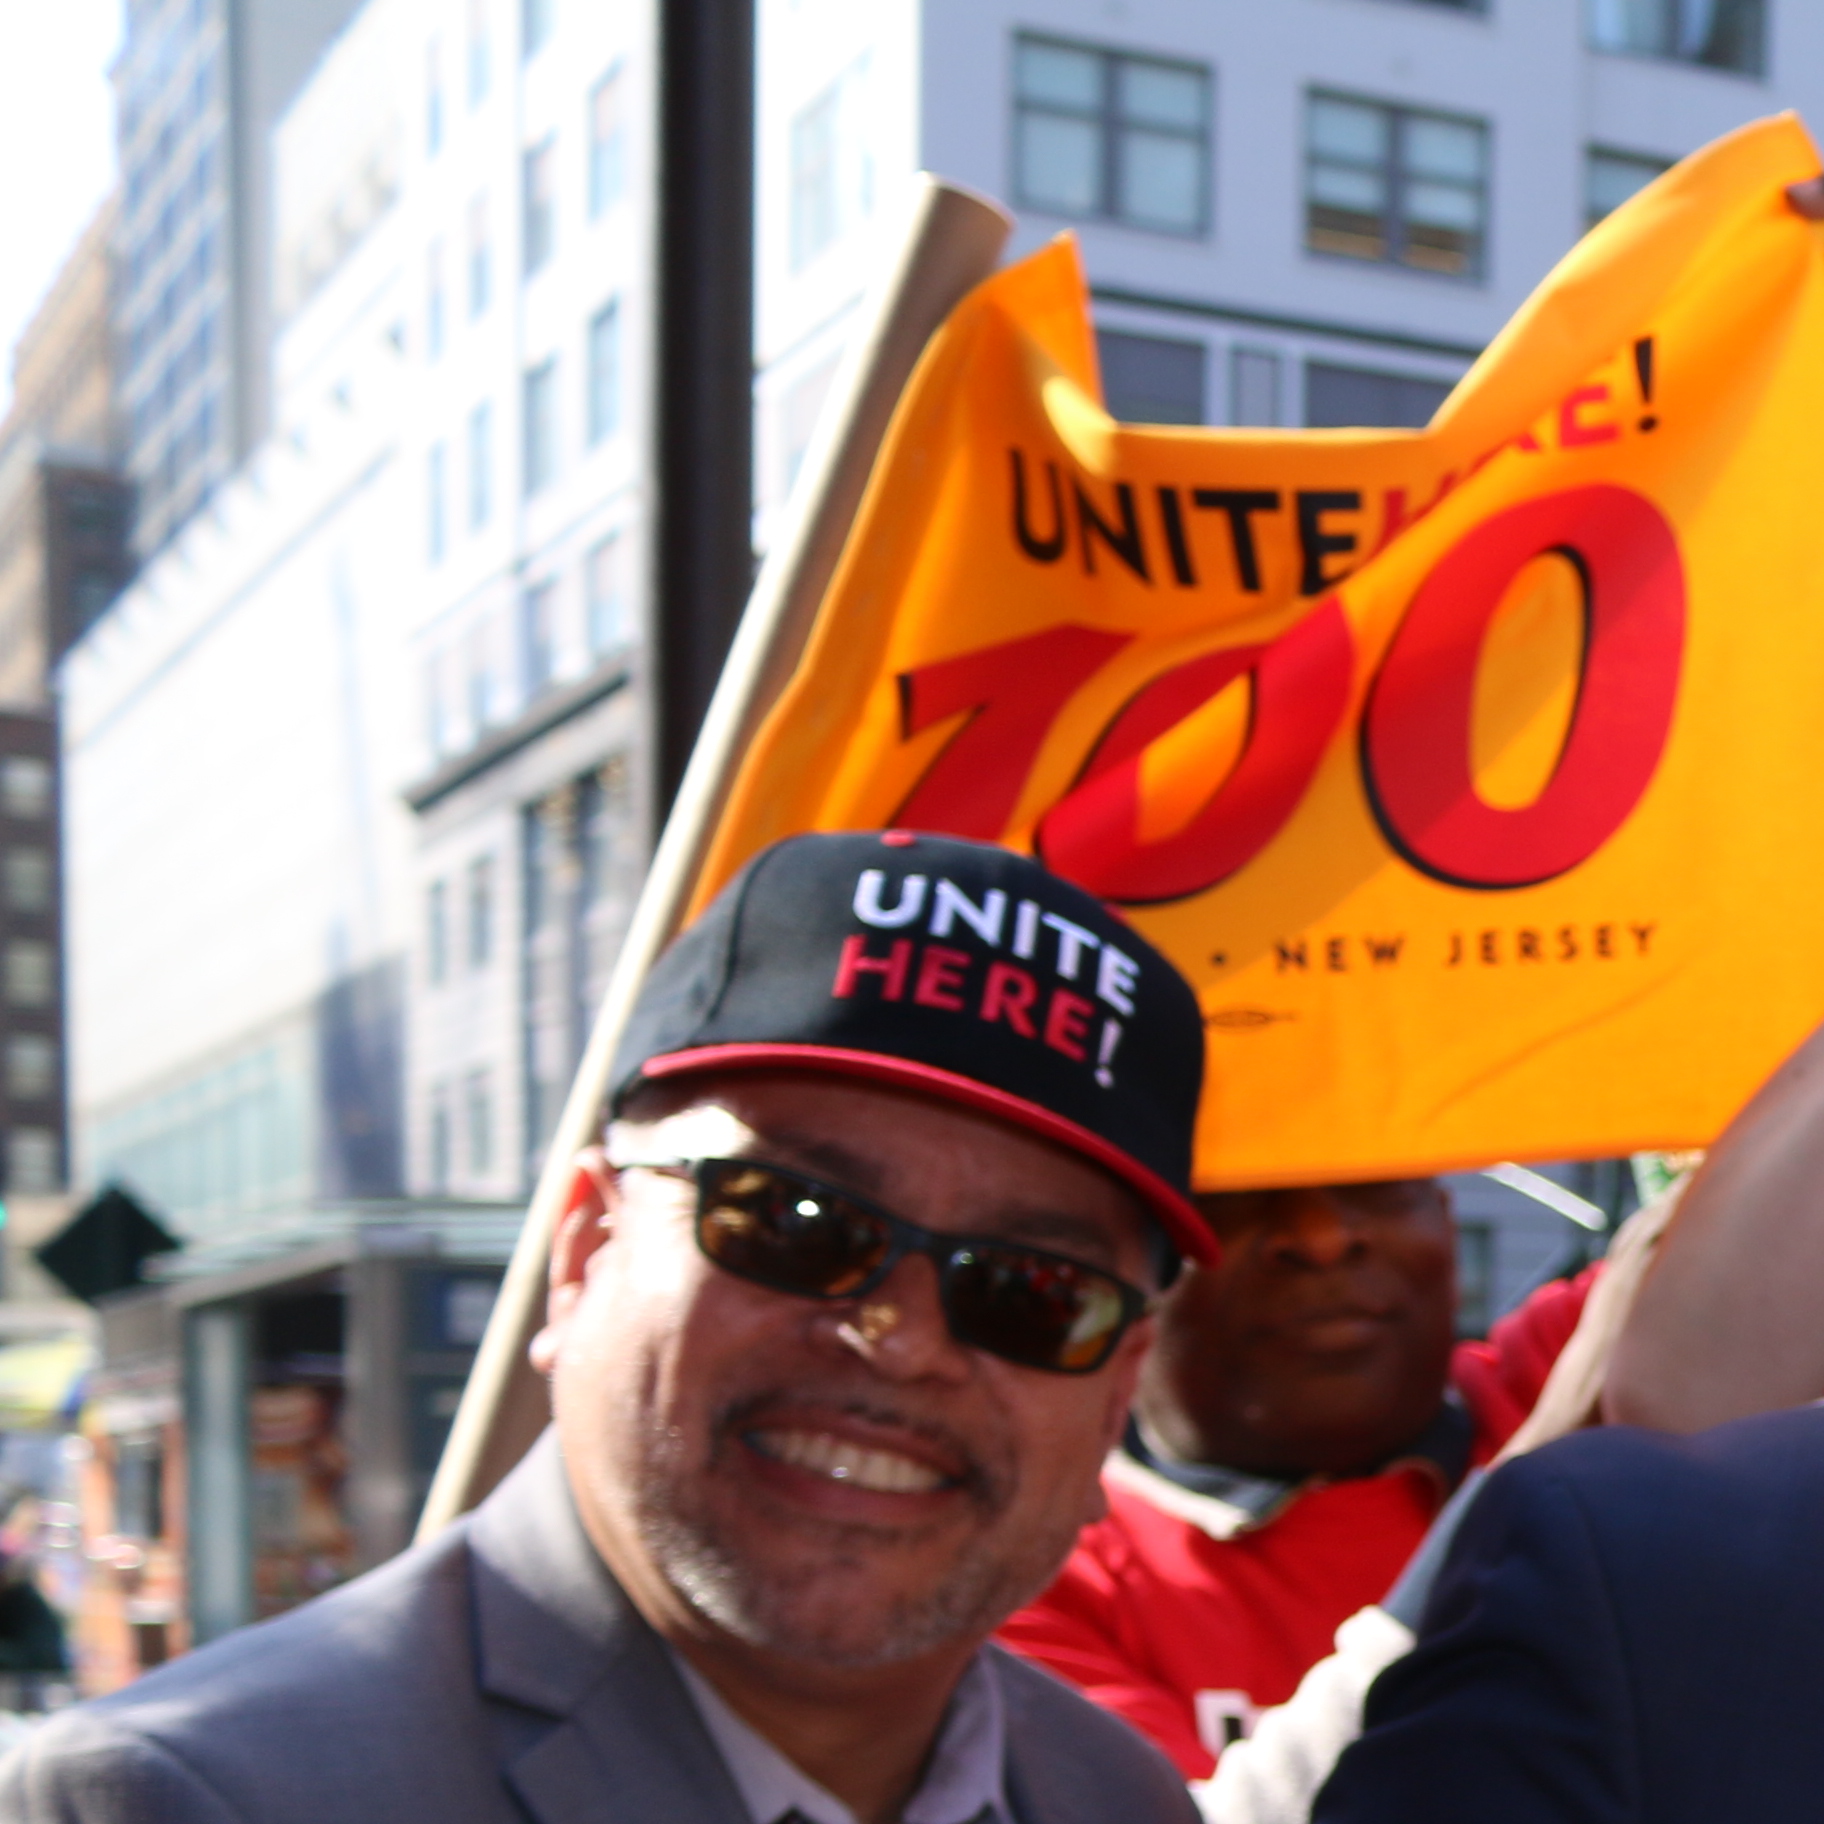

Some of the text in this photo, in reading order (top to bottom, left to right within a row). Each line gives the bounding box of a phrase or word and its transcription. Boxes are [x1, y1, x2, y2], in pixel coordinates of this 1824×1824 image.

[886, 483, 1687, 905] 100
[831, 934, 1122, 1088] HERE!
[852, 868, 1140, 1016] UNITE
[1274, 920, 1658, 974] NEW JERSEY
